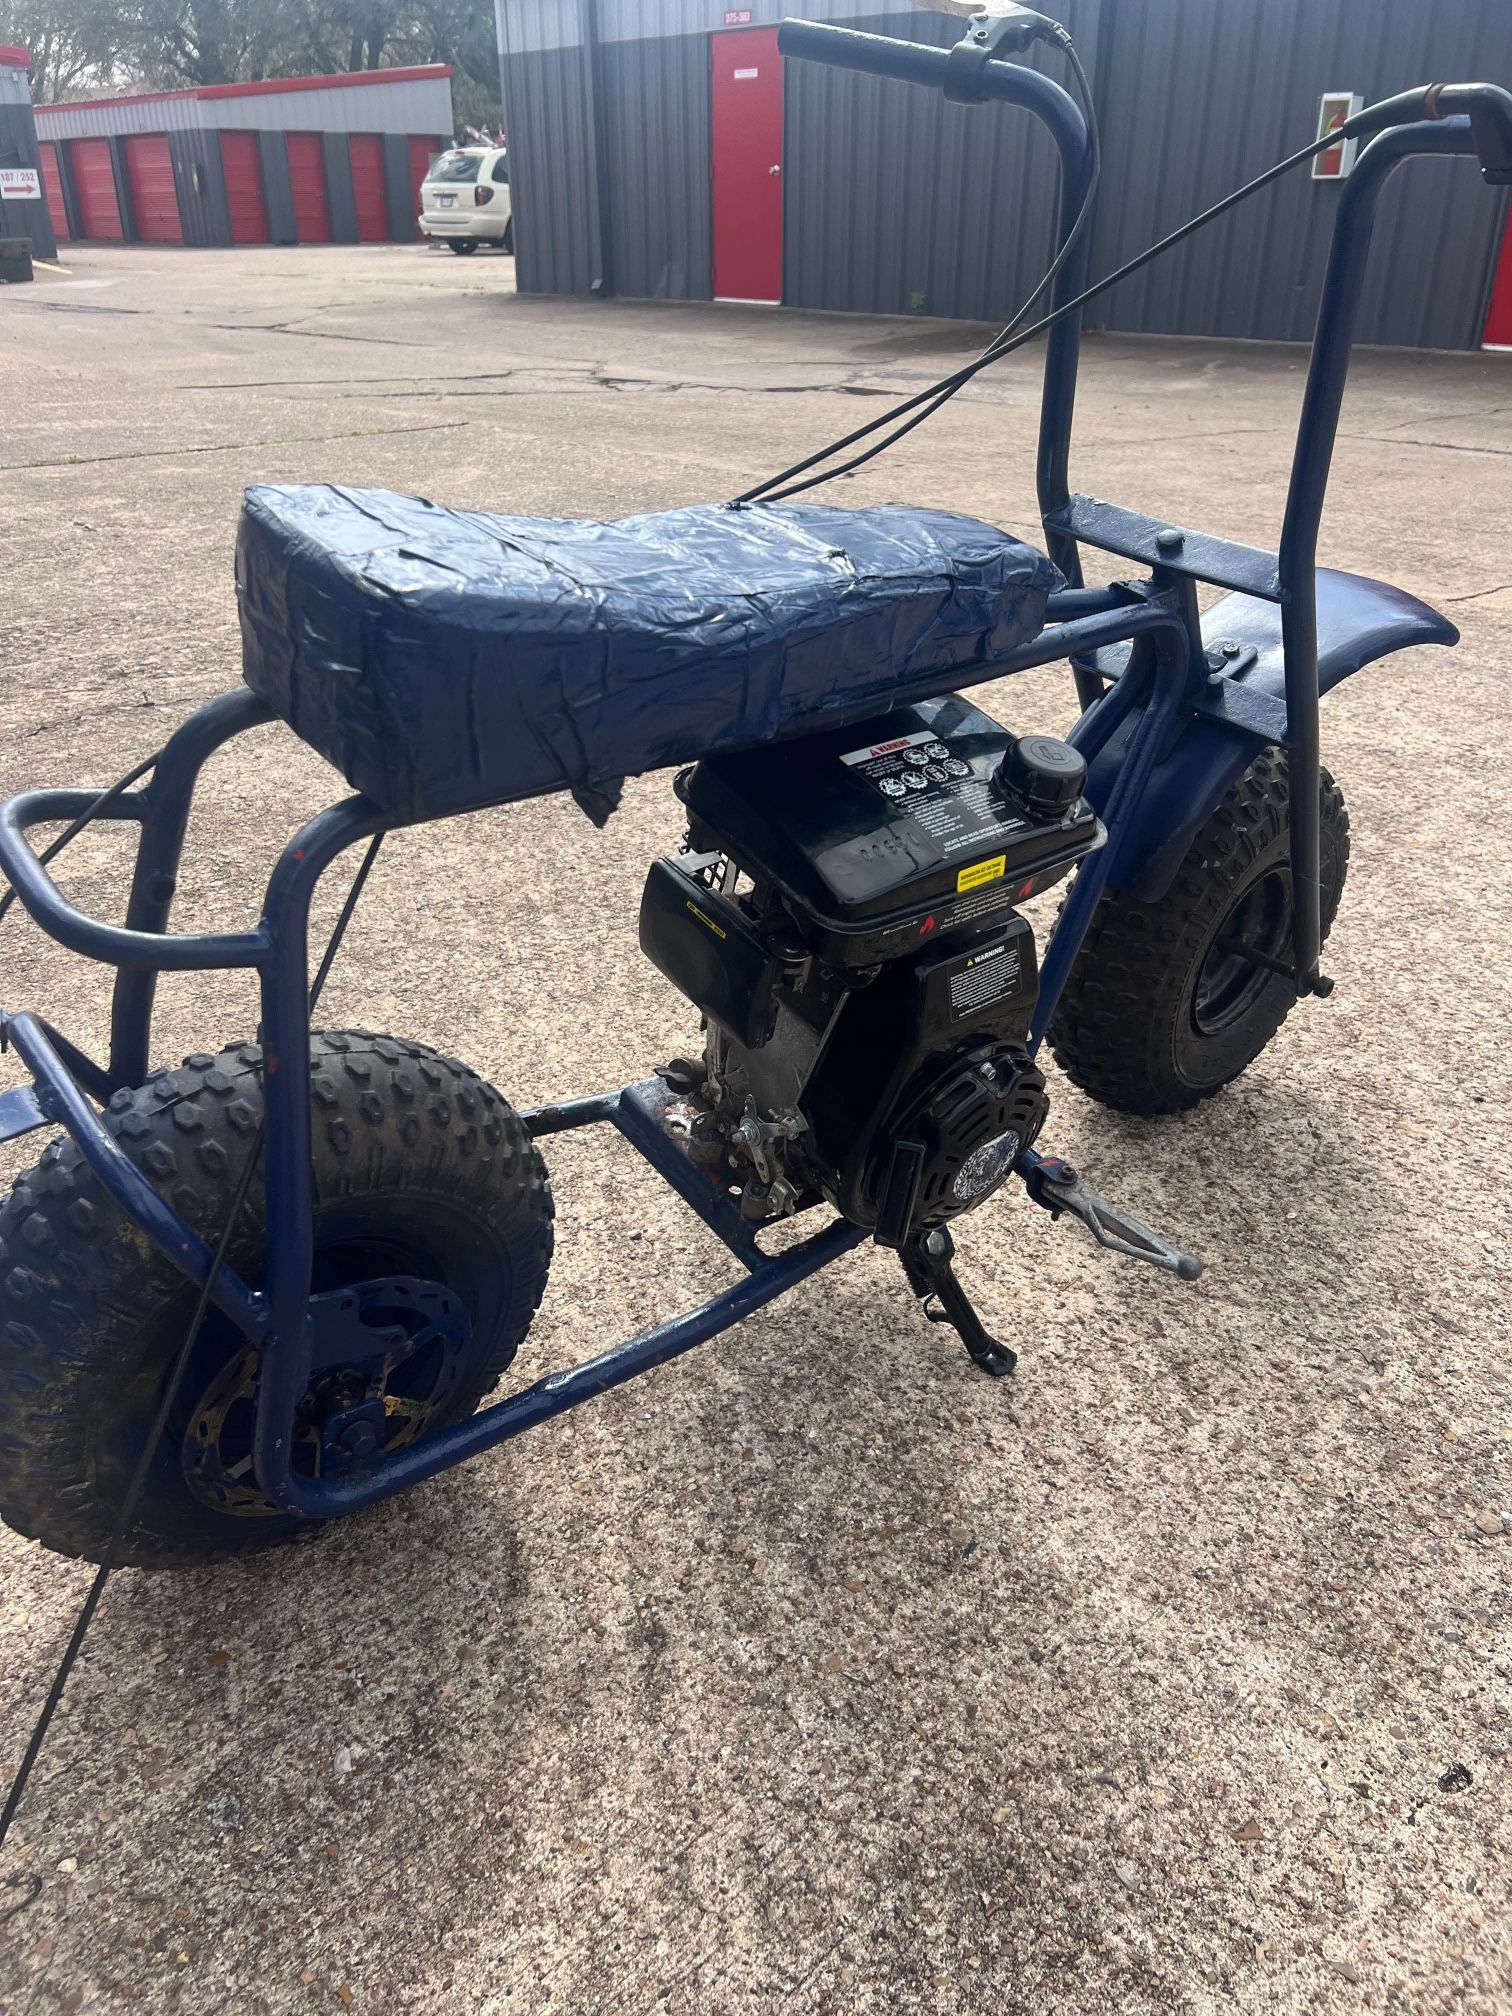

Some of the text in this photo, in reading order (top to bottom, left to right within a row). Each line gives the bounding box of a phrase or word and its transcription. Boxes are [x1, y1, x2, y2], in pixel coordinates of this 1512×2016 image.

[1, 172, 35, 182] 187 252
[877, 739, 911, 753] WARNING
[974, 945, 1005, 963] WARNING!
